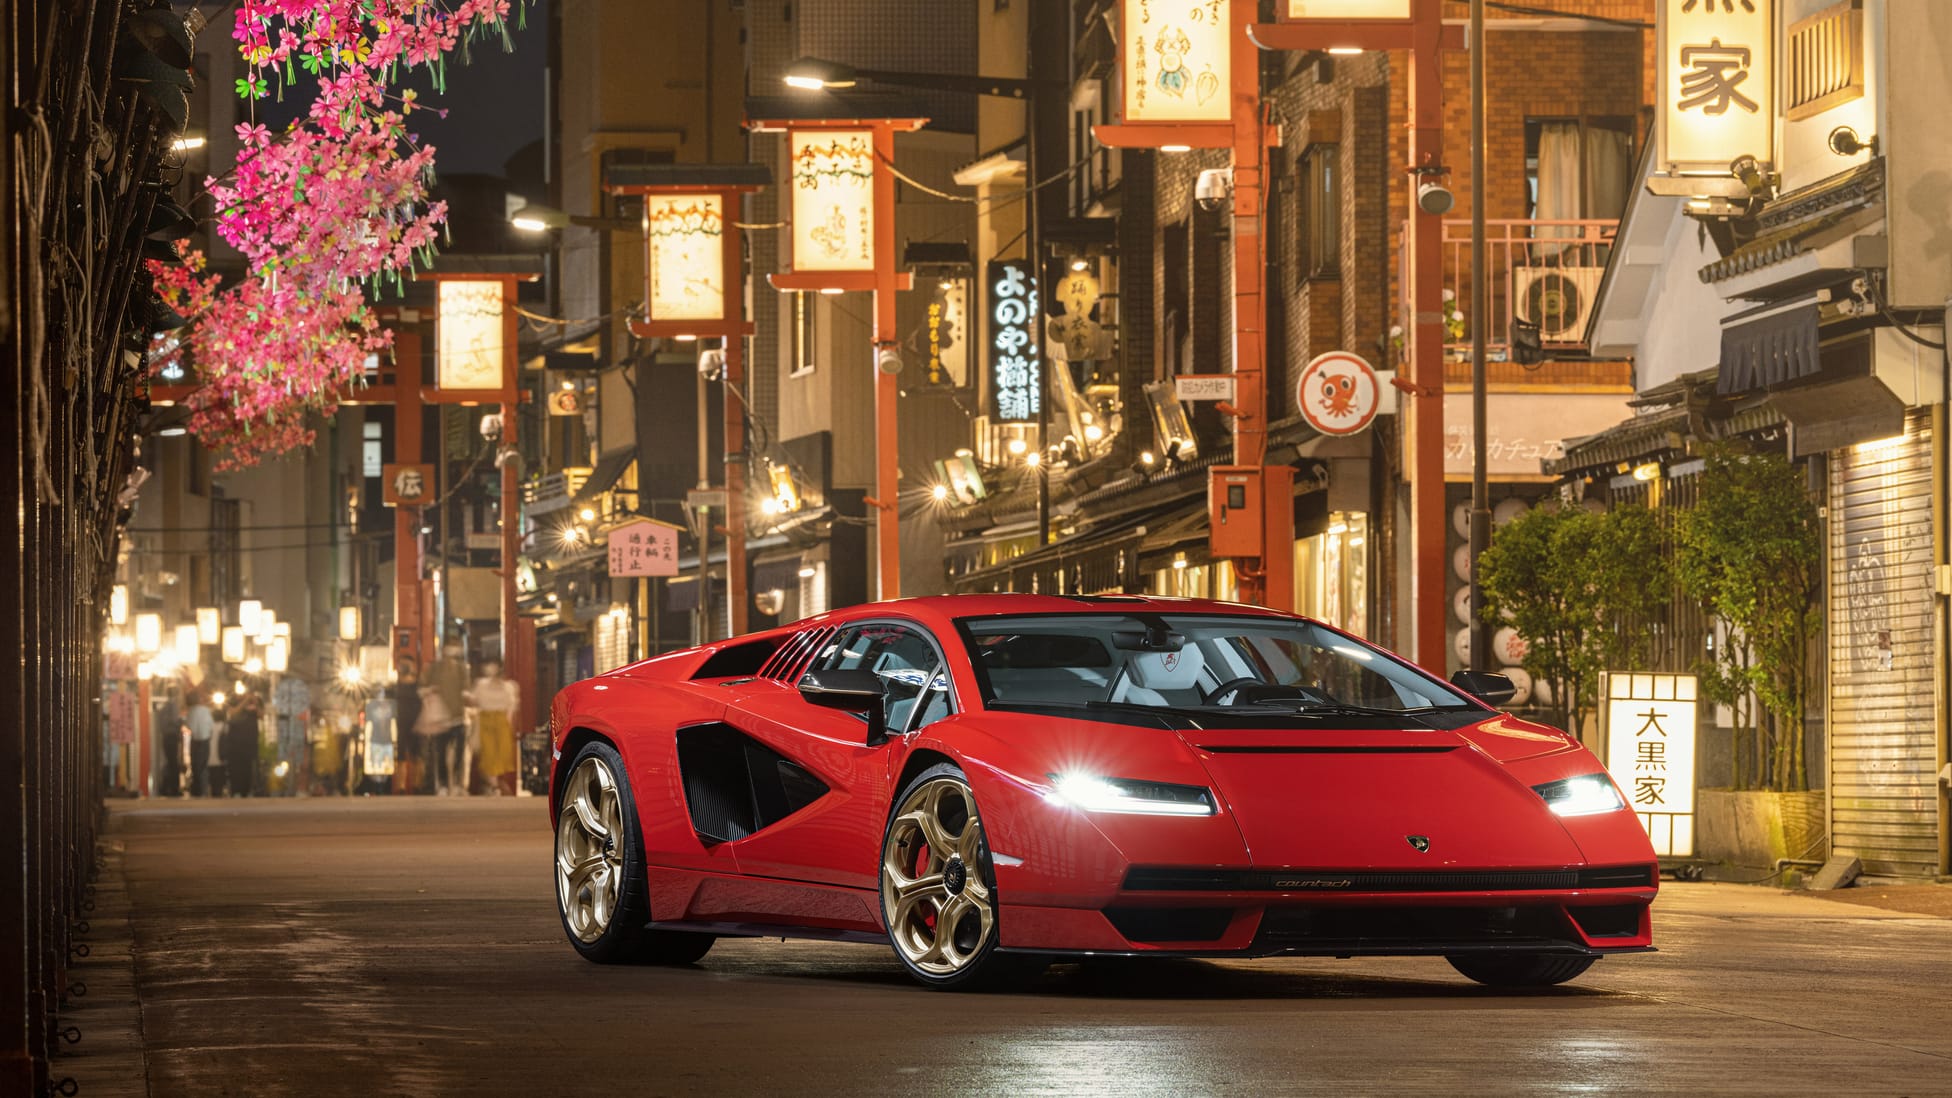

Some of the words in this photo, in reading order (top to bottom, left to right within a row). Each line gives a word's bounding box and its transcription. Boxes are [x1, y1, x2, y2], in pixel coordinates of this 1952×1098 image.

[1677, 0, 1759, 116] 家
[1445, 438, 1565, 460] カカチュア
[1635, 707, 1668, 805] 大黒家
[1275, 879, 1352, 888] countach
